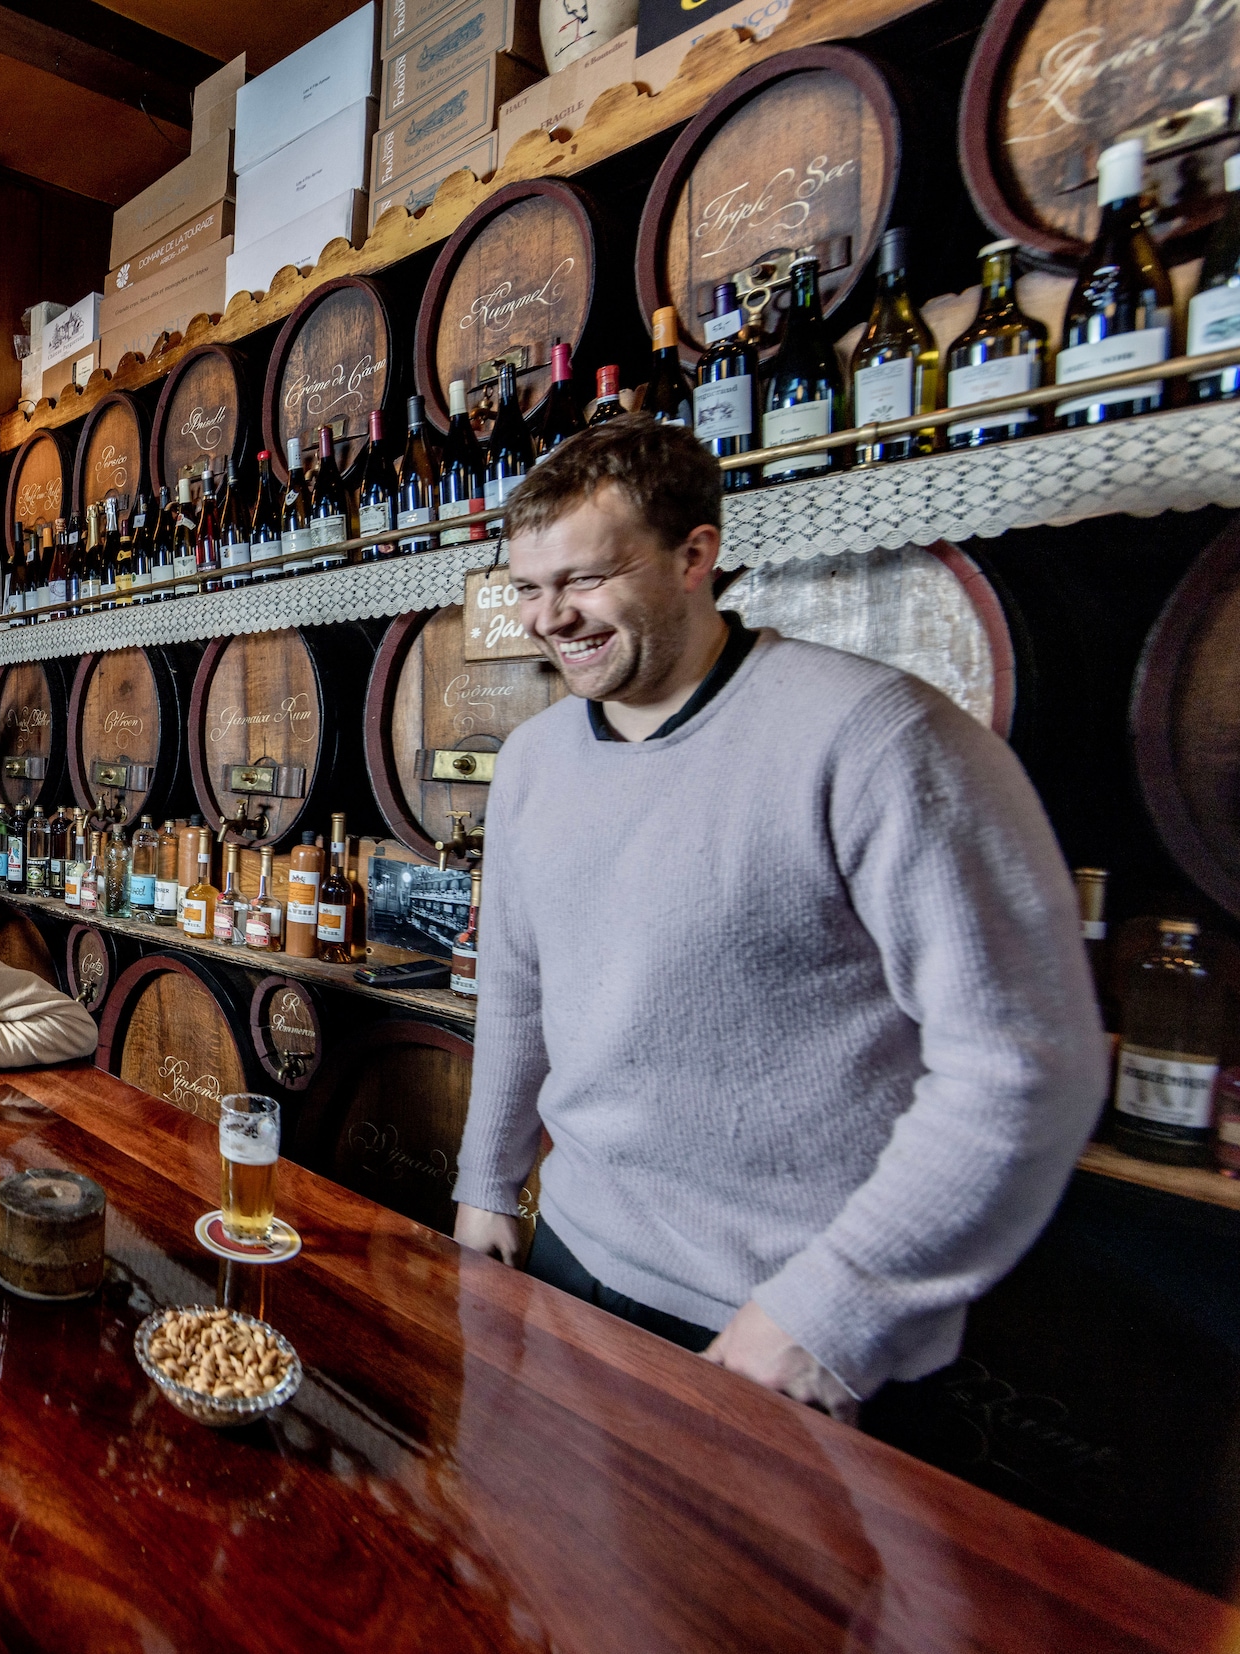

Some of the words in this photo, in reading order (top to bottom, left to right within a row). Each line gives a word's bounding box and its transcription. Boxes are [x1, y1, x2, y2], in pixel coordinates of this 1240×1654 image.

[505, 97, 529, 115] HAUT
[540, 100, 585, 130] FRAGILE
[695, 168, 795, 259] Triple
[138, 245, 166, 270] DOMAINE
[164, 240, 175, 253] DE
[174, 236, 185, 249] LA
[460, 257, 574, 331] Kummel
[331, 364, 347, 386] de
[347, 354, 387, 392] Cacao
[95, 445, 128, 474] Persico
[477, 583, 519, 609] GEO
[104, 709, 141, 735] Citroen
[210, 705, 271, 742] Jamaica
[273, 692, 316, 743] Rum
